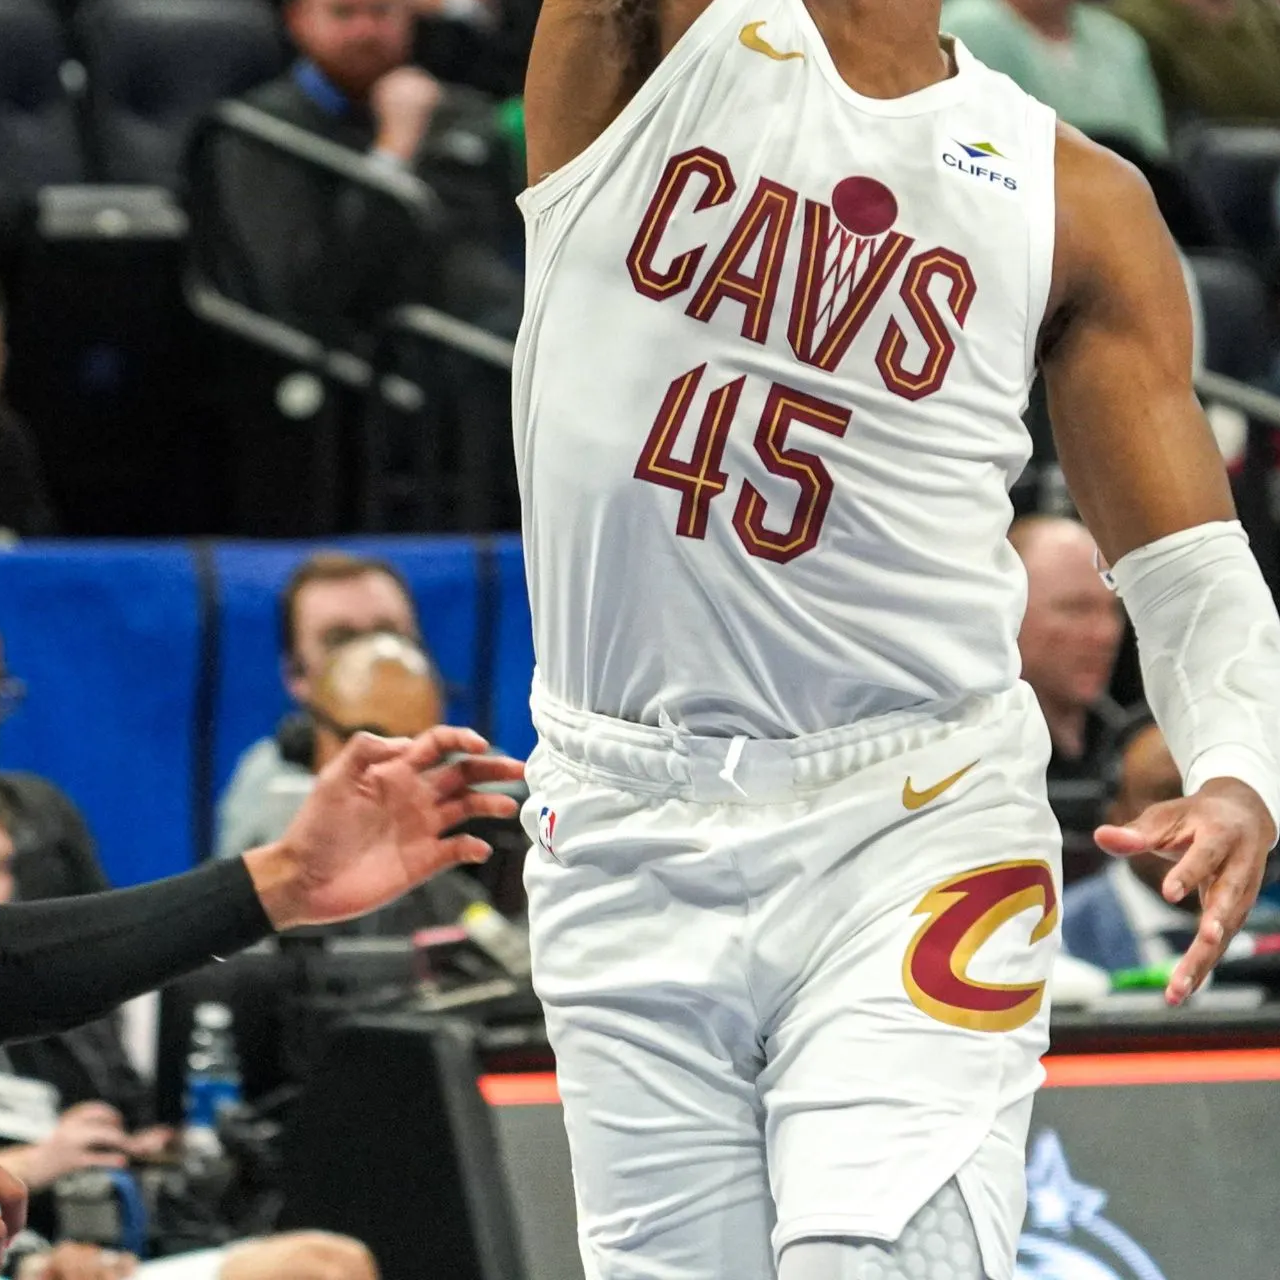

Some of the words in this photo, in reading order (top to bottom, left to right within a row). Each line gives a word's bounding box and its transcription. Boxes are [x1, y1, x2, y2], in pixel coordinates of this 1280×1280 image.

[942, 152, 1017, 191] CLIFFS
[626, 146, 978, 402] CAVS
[634, 361, 853, 565] 45
